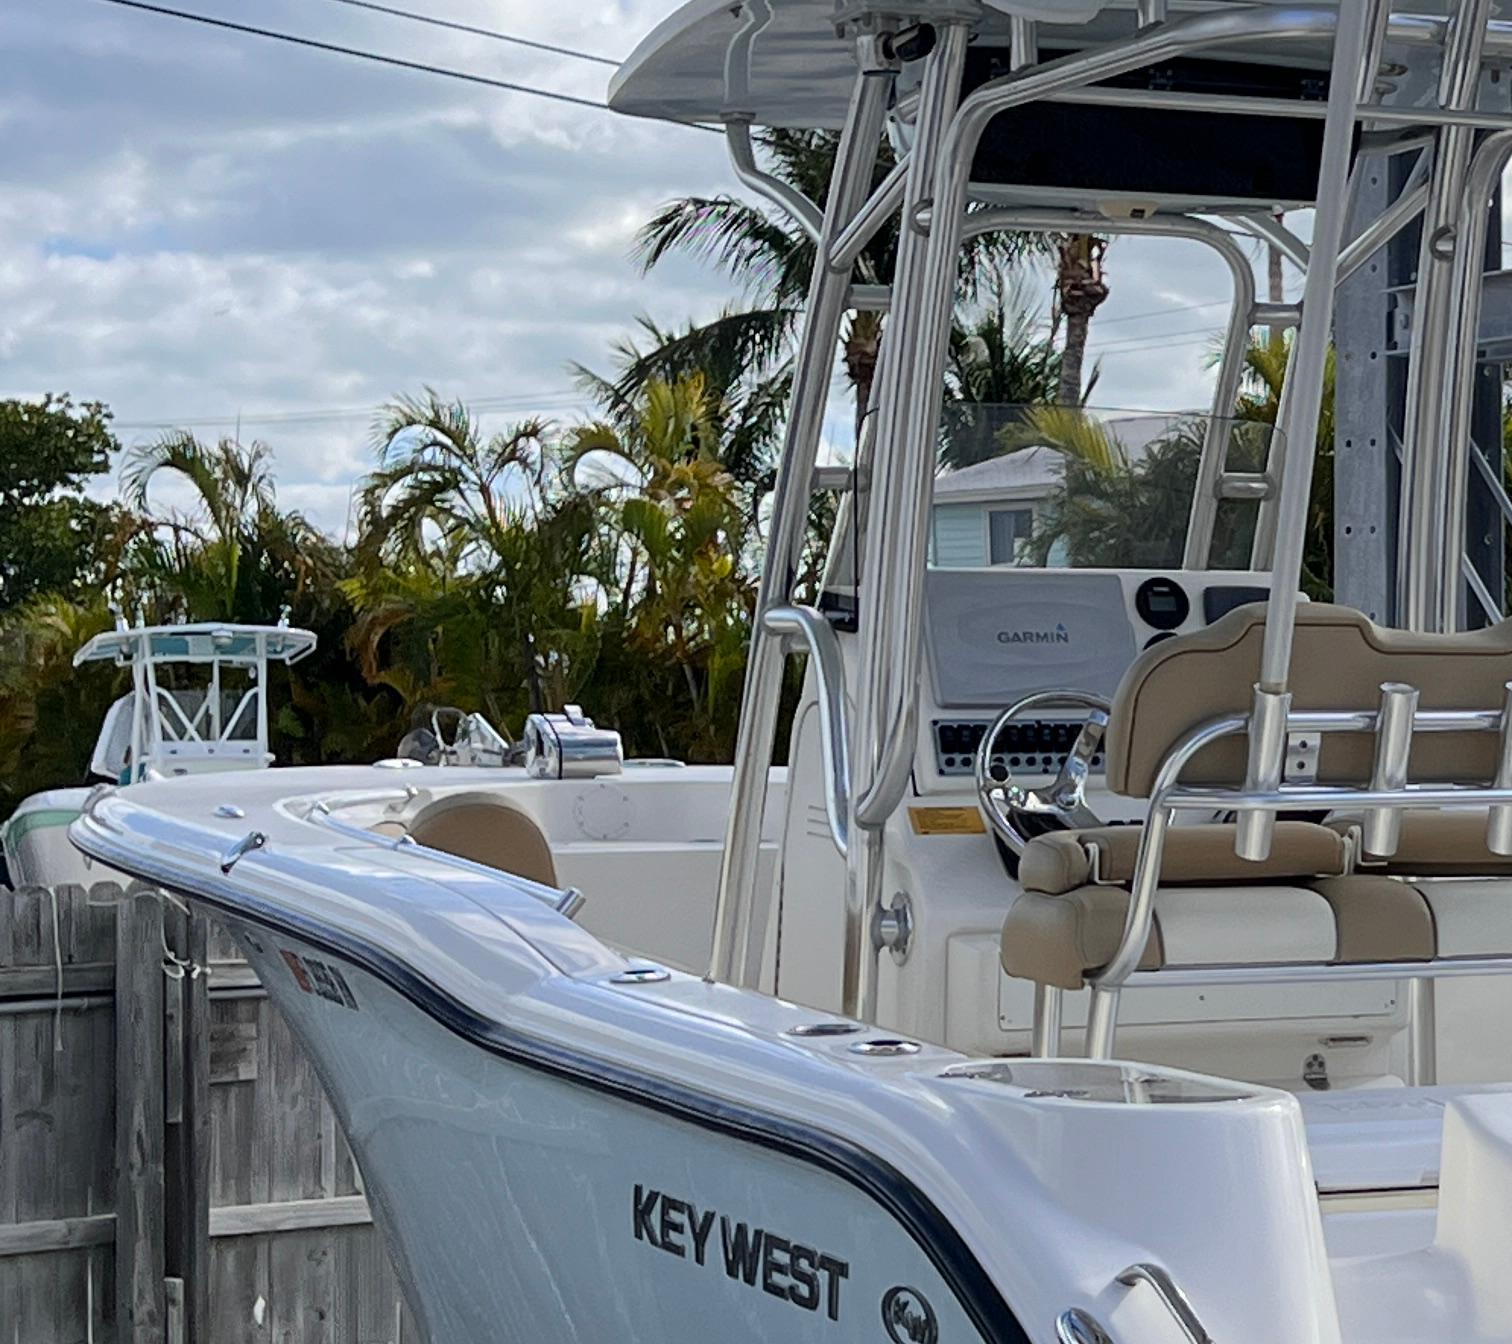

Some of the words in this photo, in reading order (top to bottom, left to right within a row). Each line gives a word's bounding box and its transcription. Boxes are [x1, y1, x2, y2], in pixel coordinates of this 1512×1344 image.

[997, 630, 1069, 644] GARMIN
[633, 1183, 716, 1267] KEY
[719, 1214, 849, 1322] WEST
